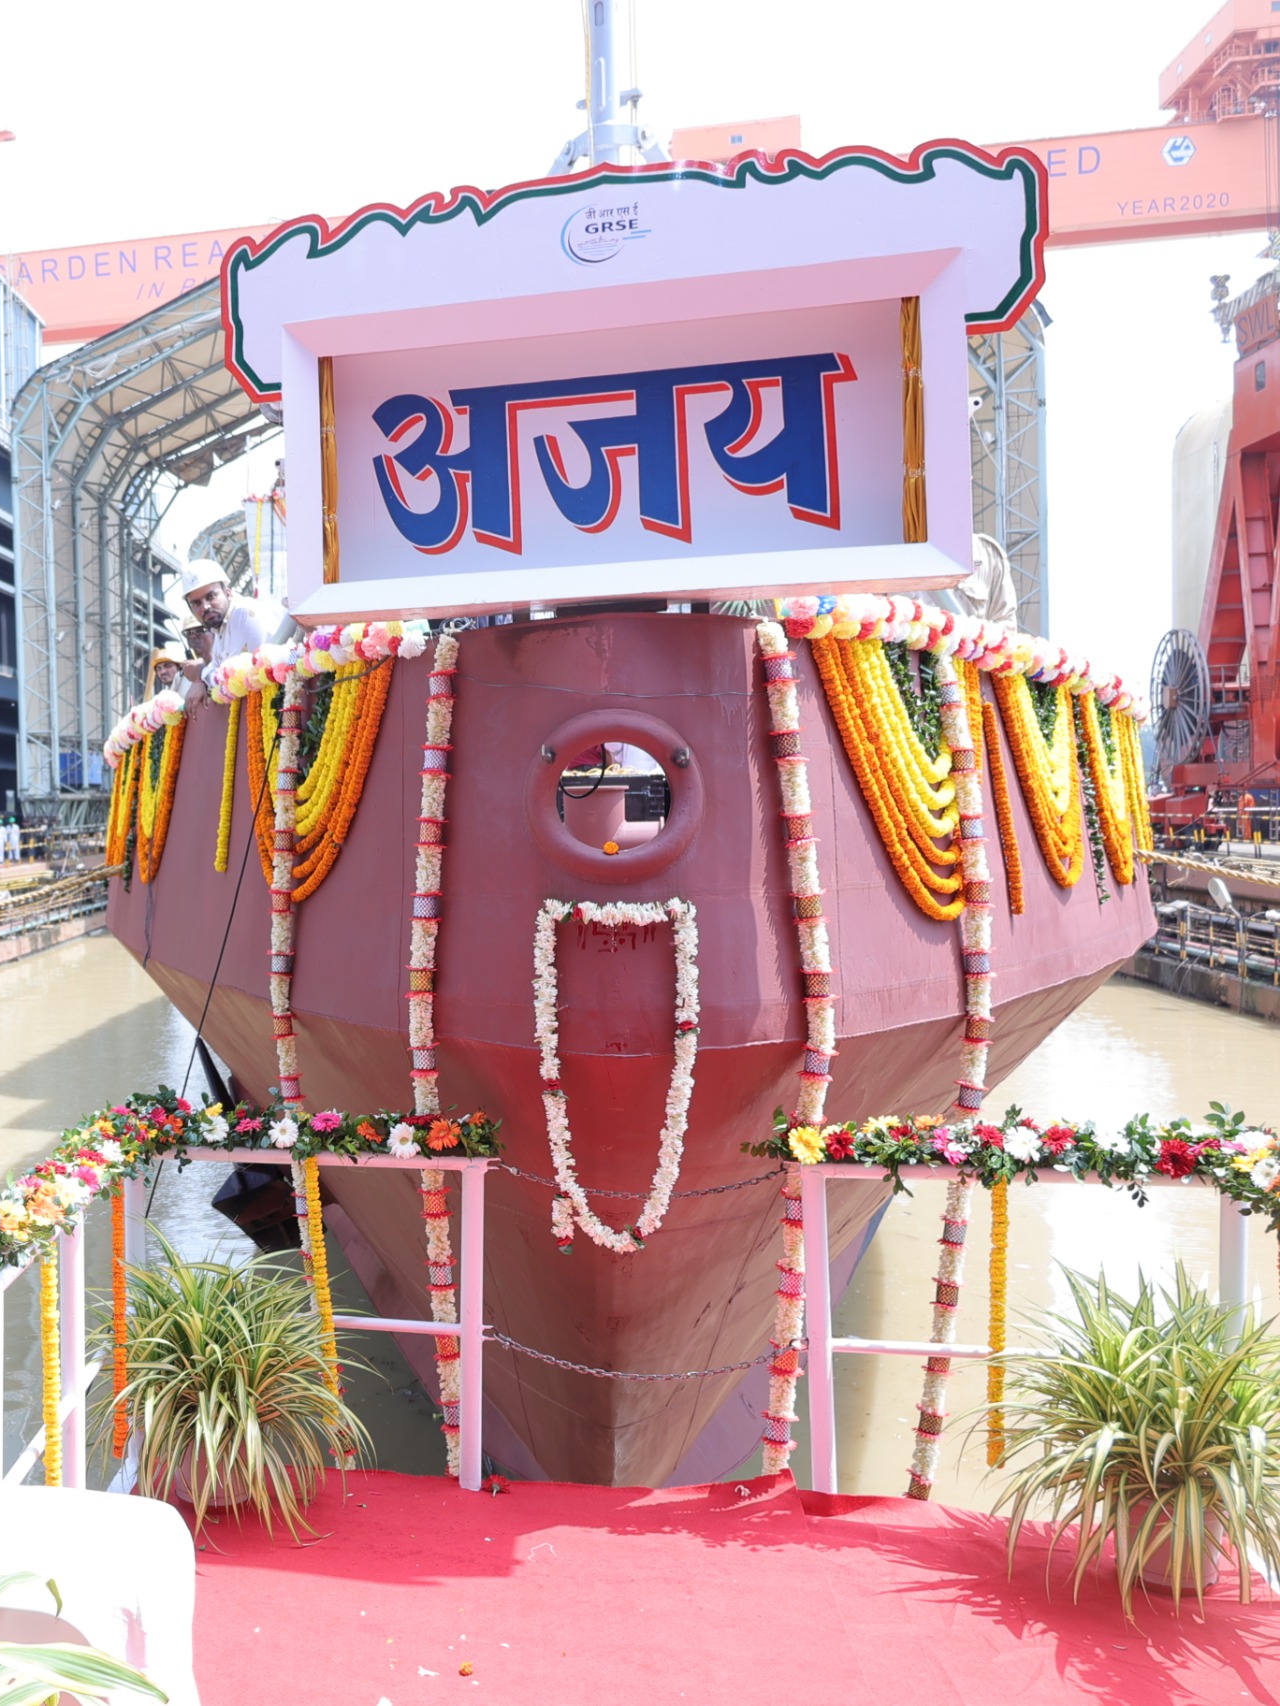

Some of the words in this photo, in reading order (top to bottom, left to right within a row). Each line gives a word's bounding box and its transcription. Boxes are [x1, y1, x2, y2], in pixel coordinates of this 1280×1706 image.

[584, 218, 639, 235] GRSE
[136, 281, 165, 300] IN
[371, 352, 858, 555] अजय
